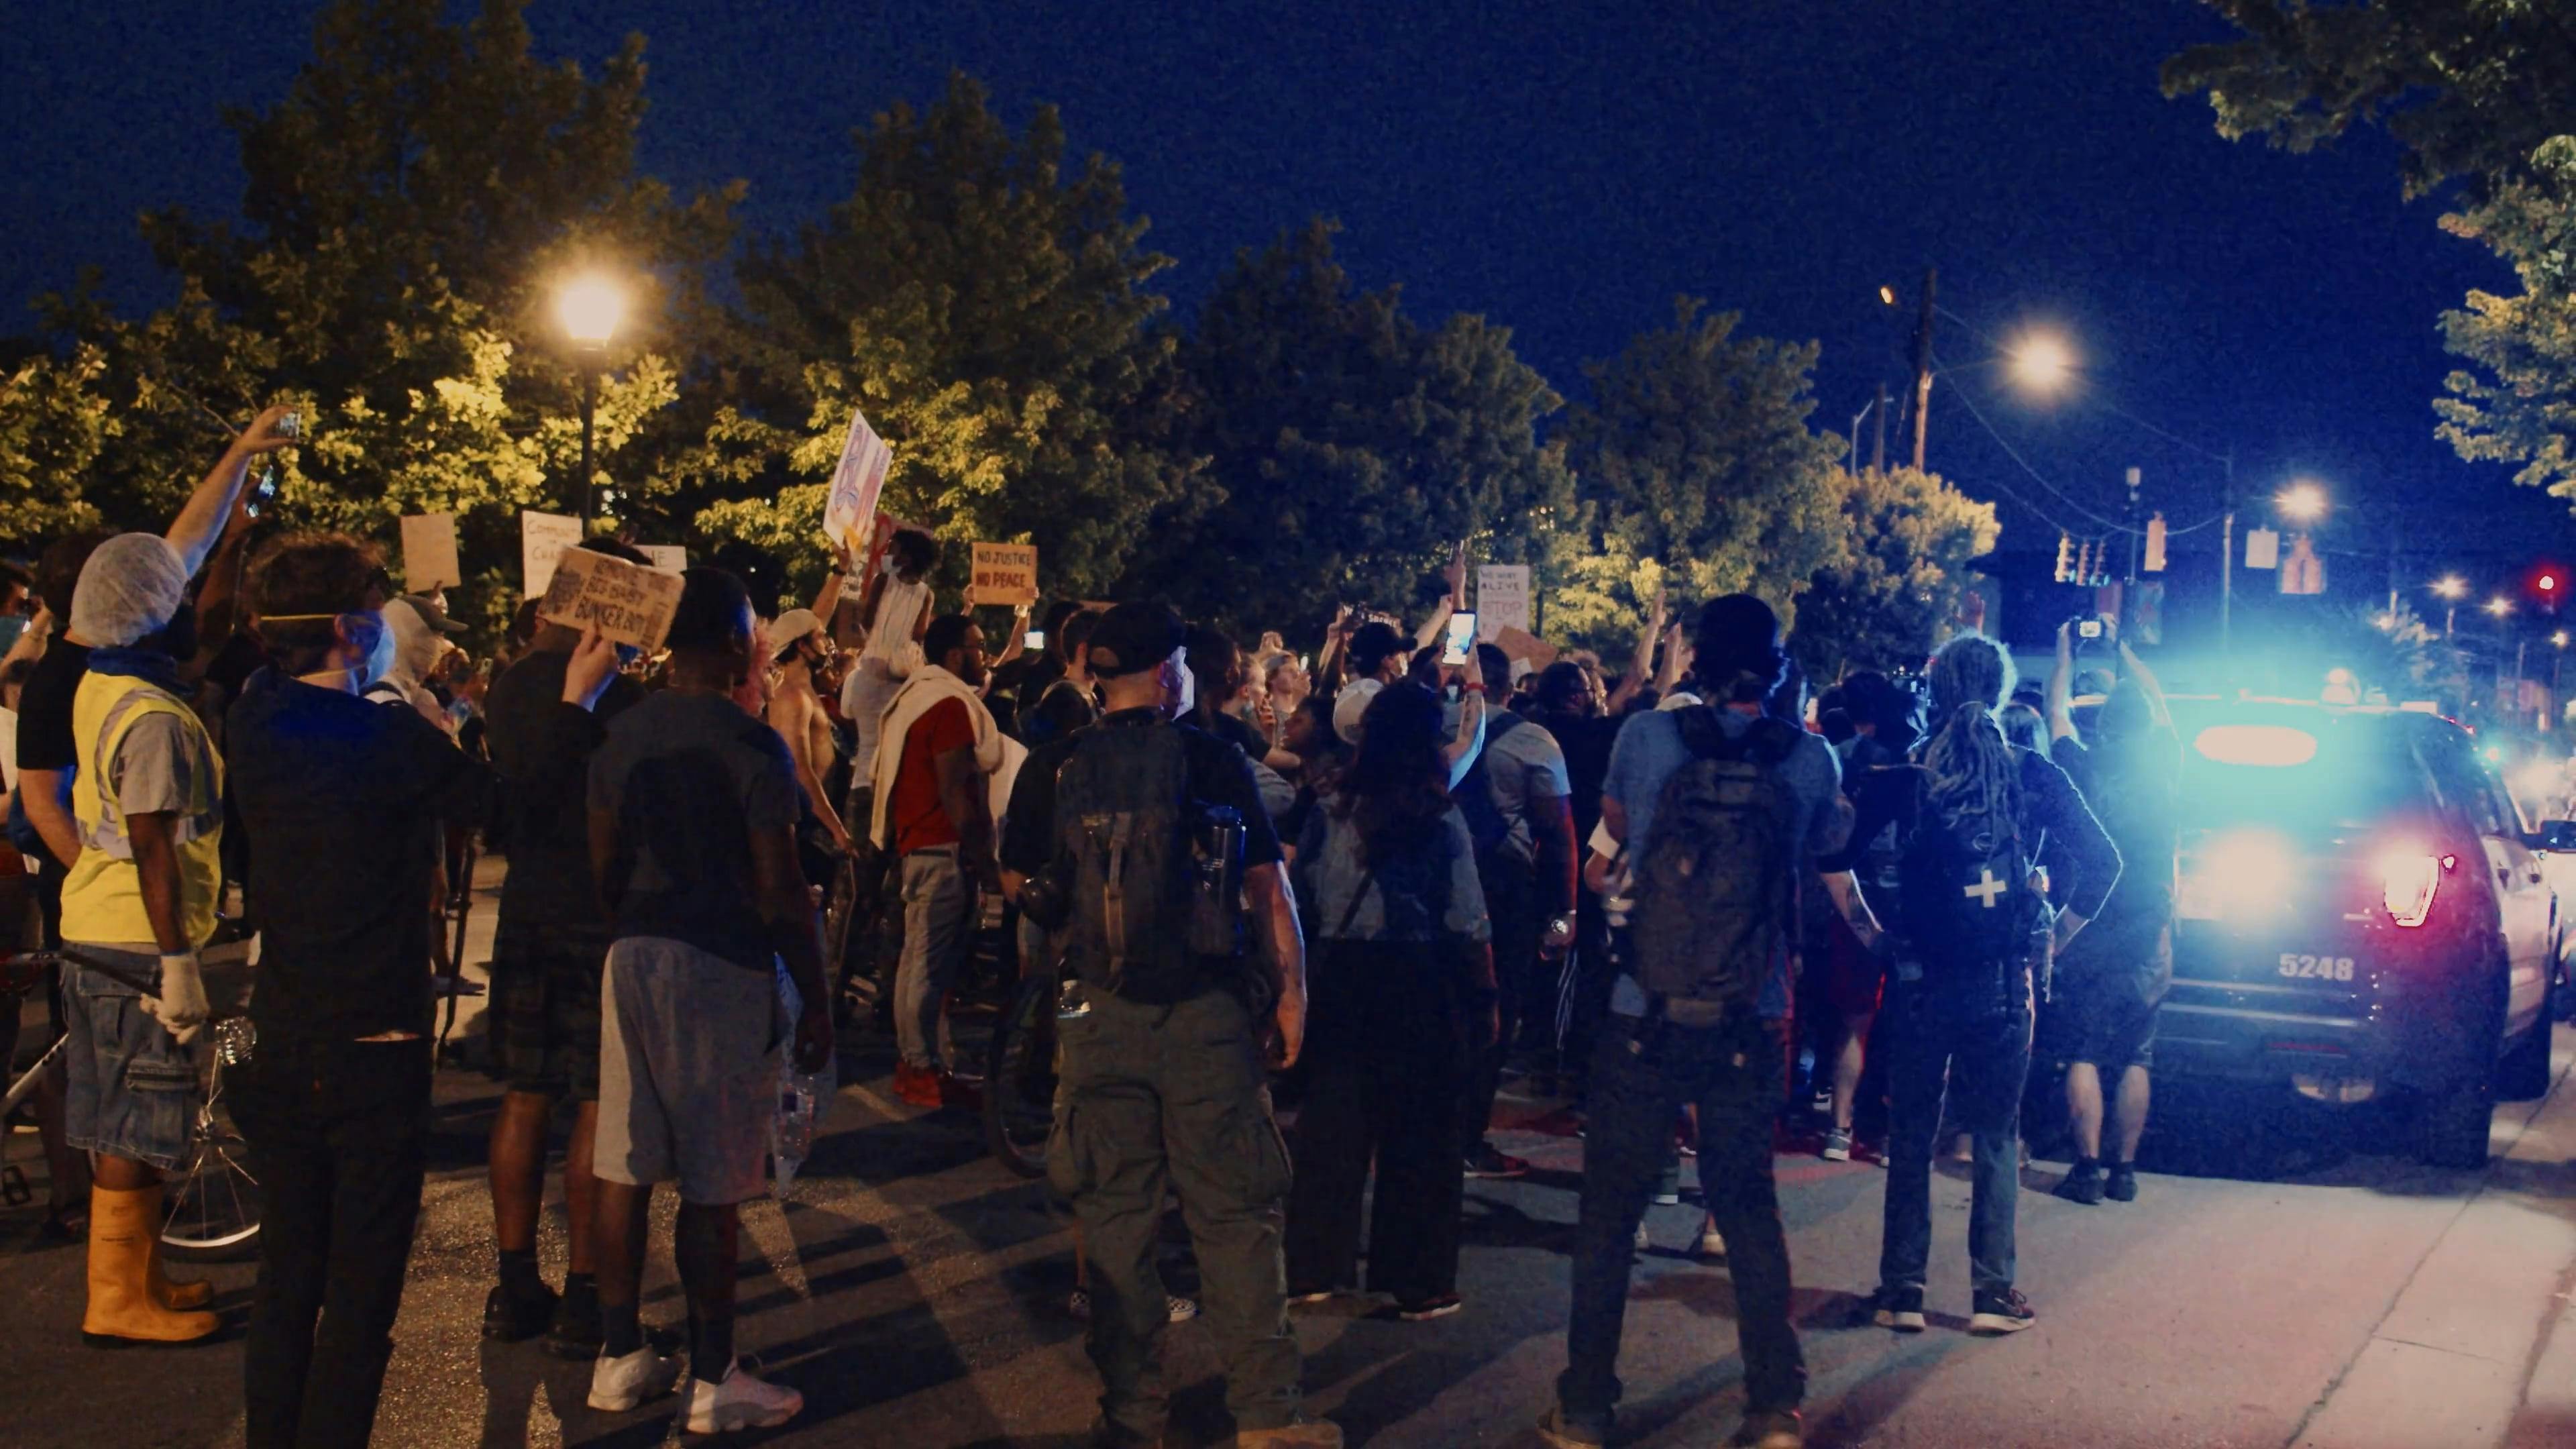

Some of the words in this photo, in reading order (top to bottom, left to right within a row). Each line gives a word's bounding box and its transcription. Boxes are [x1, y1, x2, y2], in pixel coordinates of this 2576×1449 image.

[977, 551, 990, 564] NO
[993, 551, 1030, 566] JUSTICE
[977, 572, 991, 586] NO
[993, 572, 1026, 588] PEACE
[1481, 582, 1519, 591] ALIVE
[1482, 600, 1523, 620] STOP
[2279, 953, 2354, 981] 5248
